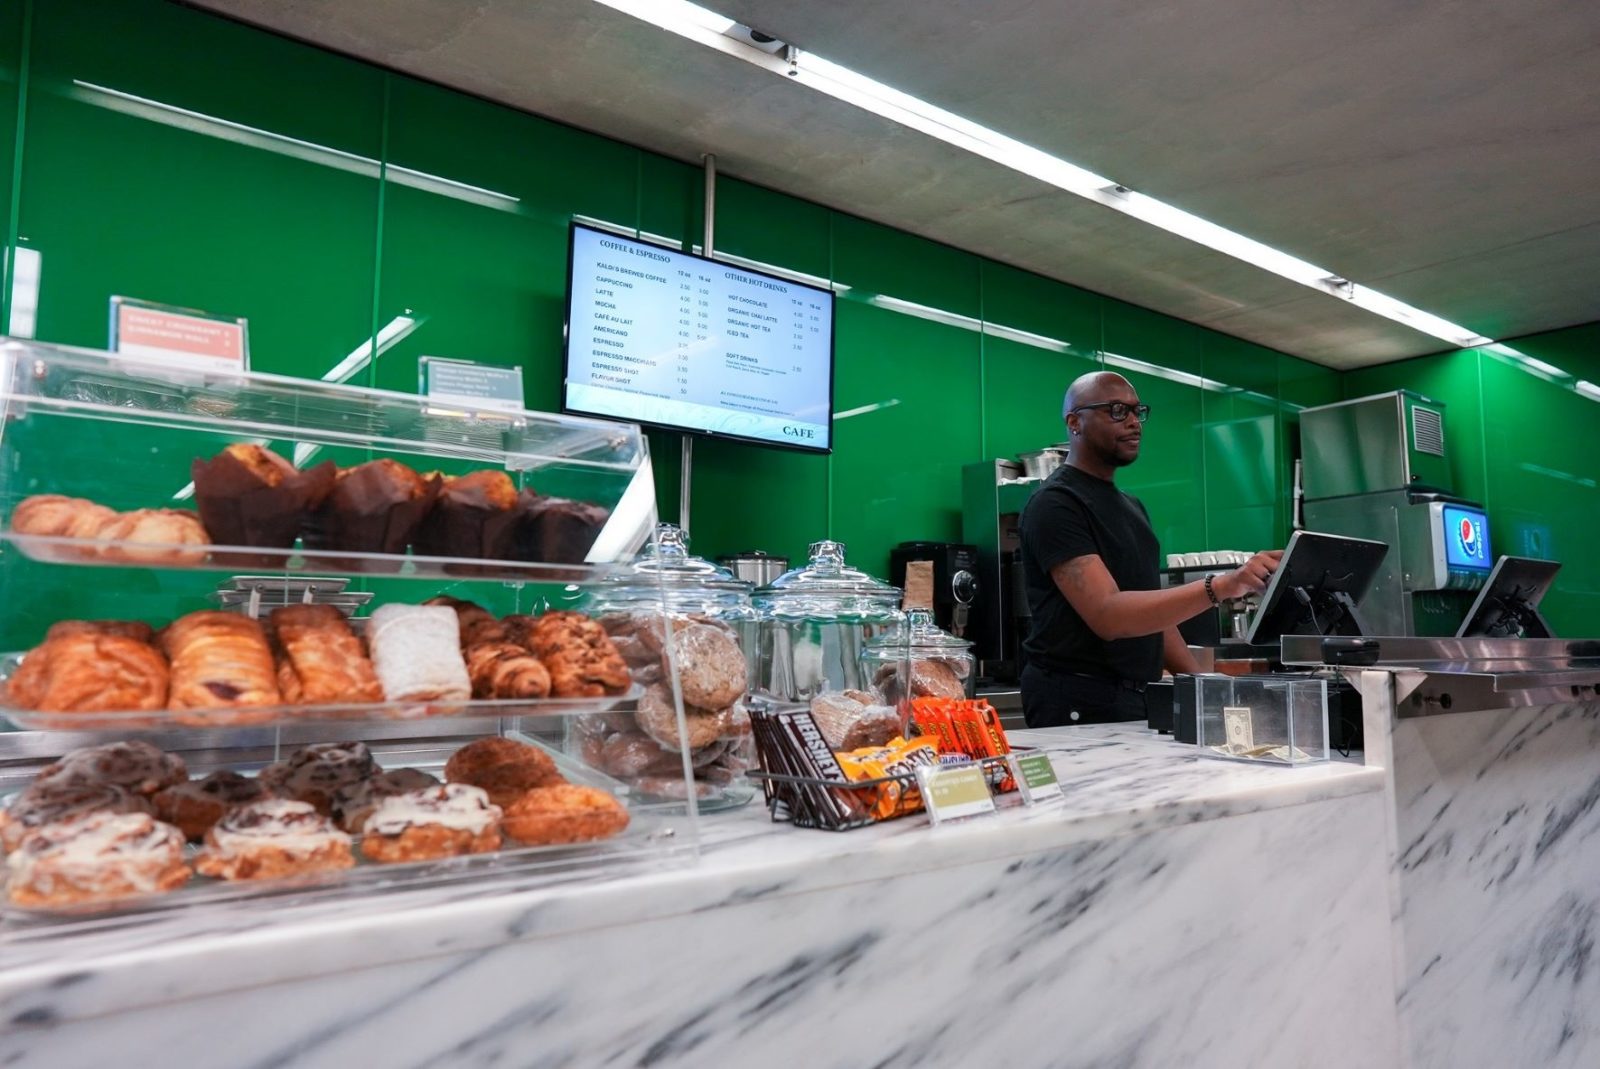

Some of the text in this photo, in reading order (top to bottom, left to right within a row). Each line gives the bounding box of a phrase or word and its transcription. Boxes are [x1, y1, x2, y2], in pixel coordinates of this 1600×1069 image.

[600, 240, 628, 252] COFFEE
[636, 249, 671, 263] ESPRESSO
[621, 267, 644, 278] BREWED
[646, 274, 667, 284] COFFEE
[596, 276, 633, 289] CAPPUCCINO
[725, 272, 788, 293] OTHER HOT DRINKS
[596, 288, 614, 297] LATTE
[595, 301, 616, 309] MOCHA
[739, 296, 768, 308] CHOCOLATE
[728, 307, 749, 316] ORGANIC
[763, 315, 778, 323] LATTE
[728, 319, 749, 328] ORGANIC
[594, 325, 628, 336] AMERICANO
[593, 337, 624, 348] ESPRESSO
[592, 350, 623, 360] ESPRESSO
[592, 362, 622, 372] ESPRESSO
[592, 372, 614, 381] FLAVOR
[783, 426, 814, 439] CAFE
